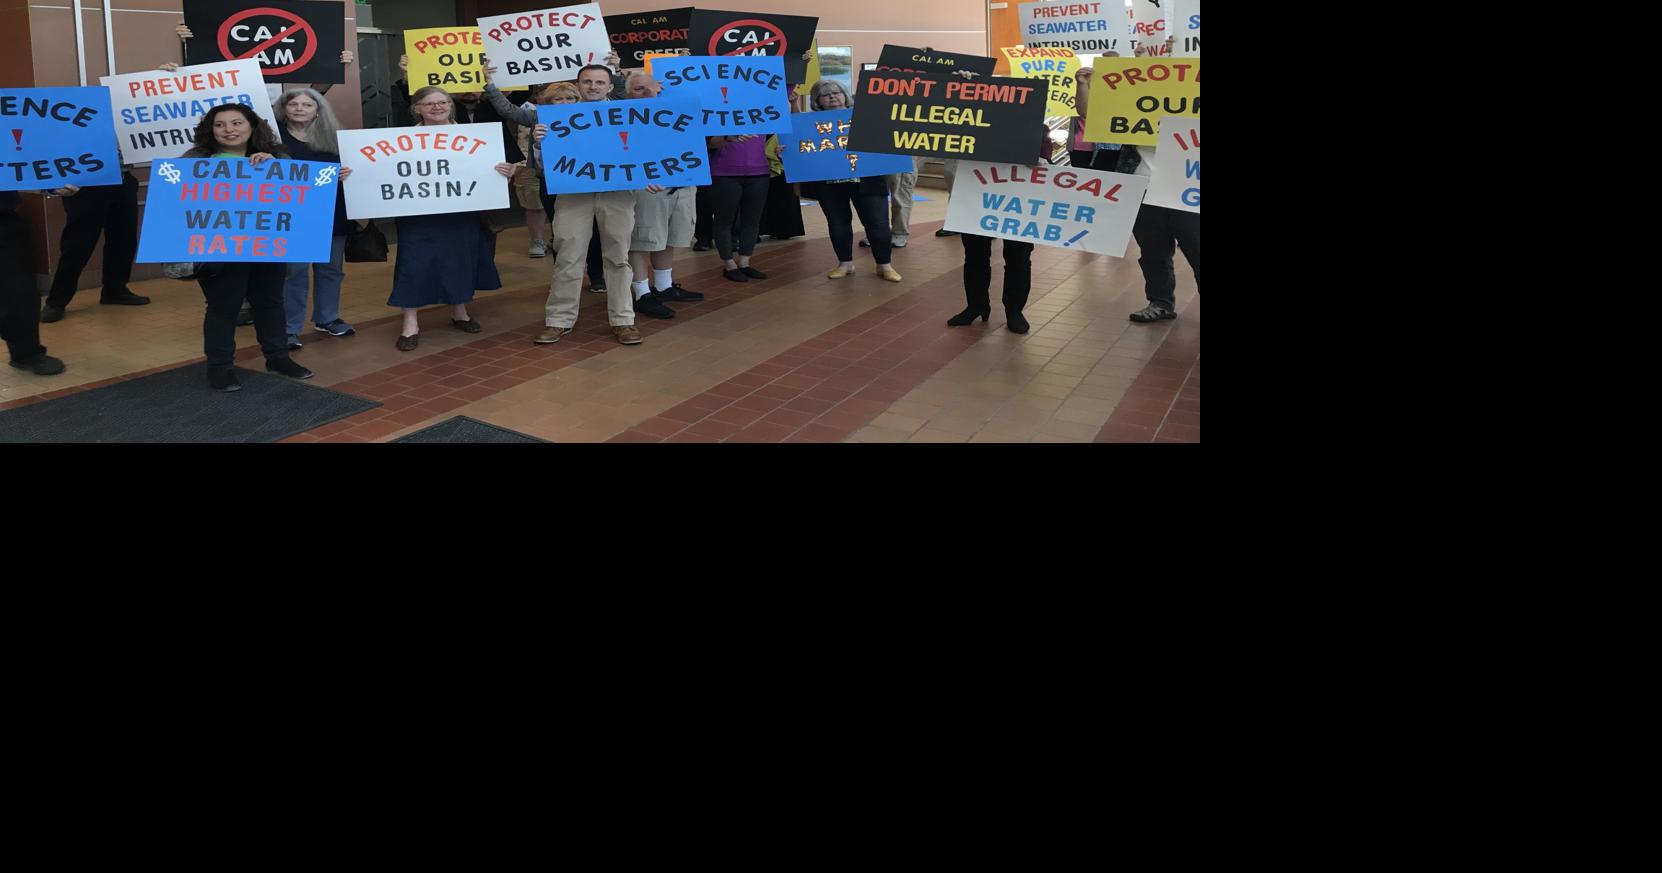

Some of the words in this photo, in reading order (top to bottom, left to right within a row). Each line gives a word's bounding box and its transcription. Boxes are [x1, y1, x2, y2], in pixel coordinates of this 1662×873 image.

[631, 17, 648, 26] CAL
[652, 16, 668, 24] AM
[1033, 2, 1100, 19] PREVENT
[230, 24, 295, 43] CAL
[487, 12, 596, 42] PROTECT
[724, 29, 775, 46] CAL
[1028, 19, 1107, 34] SEAWATER
[517, 33, 572, 52] OUR
[1007, 47, 1074, 58] EXPAND
[506, 52, 594, 76] BASIN!
[912, 54, 932, 64] CAL
[936, 58, 955, 66] AM
[1021, 59, 1067, 74] PURE
[128, 69, 241, 99] PREVENT
[664, 63, 783, 91] SCIENCE
[1102, 63, 1200, 90] PROT
[867, 76, 936, 97] DON'T
[945, 81, 1034, 105] PERMIT
[550, 107, 694, 138] SCIENCE
[890, 103, 992, 127] ILLEGAL
[359, 133, 487, 163] PROTECT
[893, 130, 976, 154] WATER
[0, 153, 104, 182] TERS
[192, 159, 310, 182] CAL-AM
[396, 159, 450, 178] OUR
[553, 151, 702, 182] MATTERS
[180, 181, 311, 205] HIGHEST
[380, 180, 478, 201] BASIN!
[973, 165, 1122, 202] ILLEGAL
[982, 192, 1096, 224] WATER
[185, 209, 293, 232] WATER
[980, 214, 1089, 247] GRAB!
[187, 234, 288, 257] RATES
